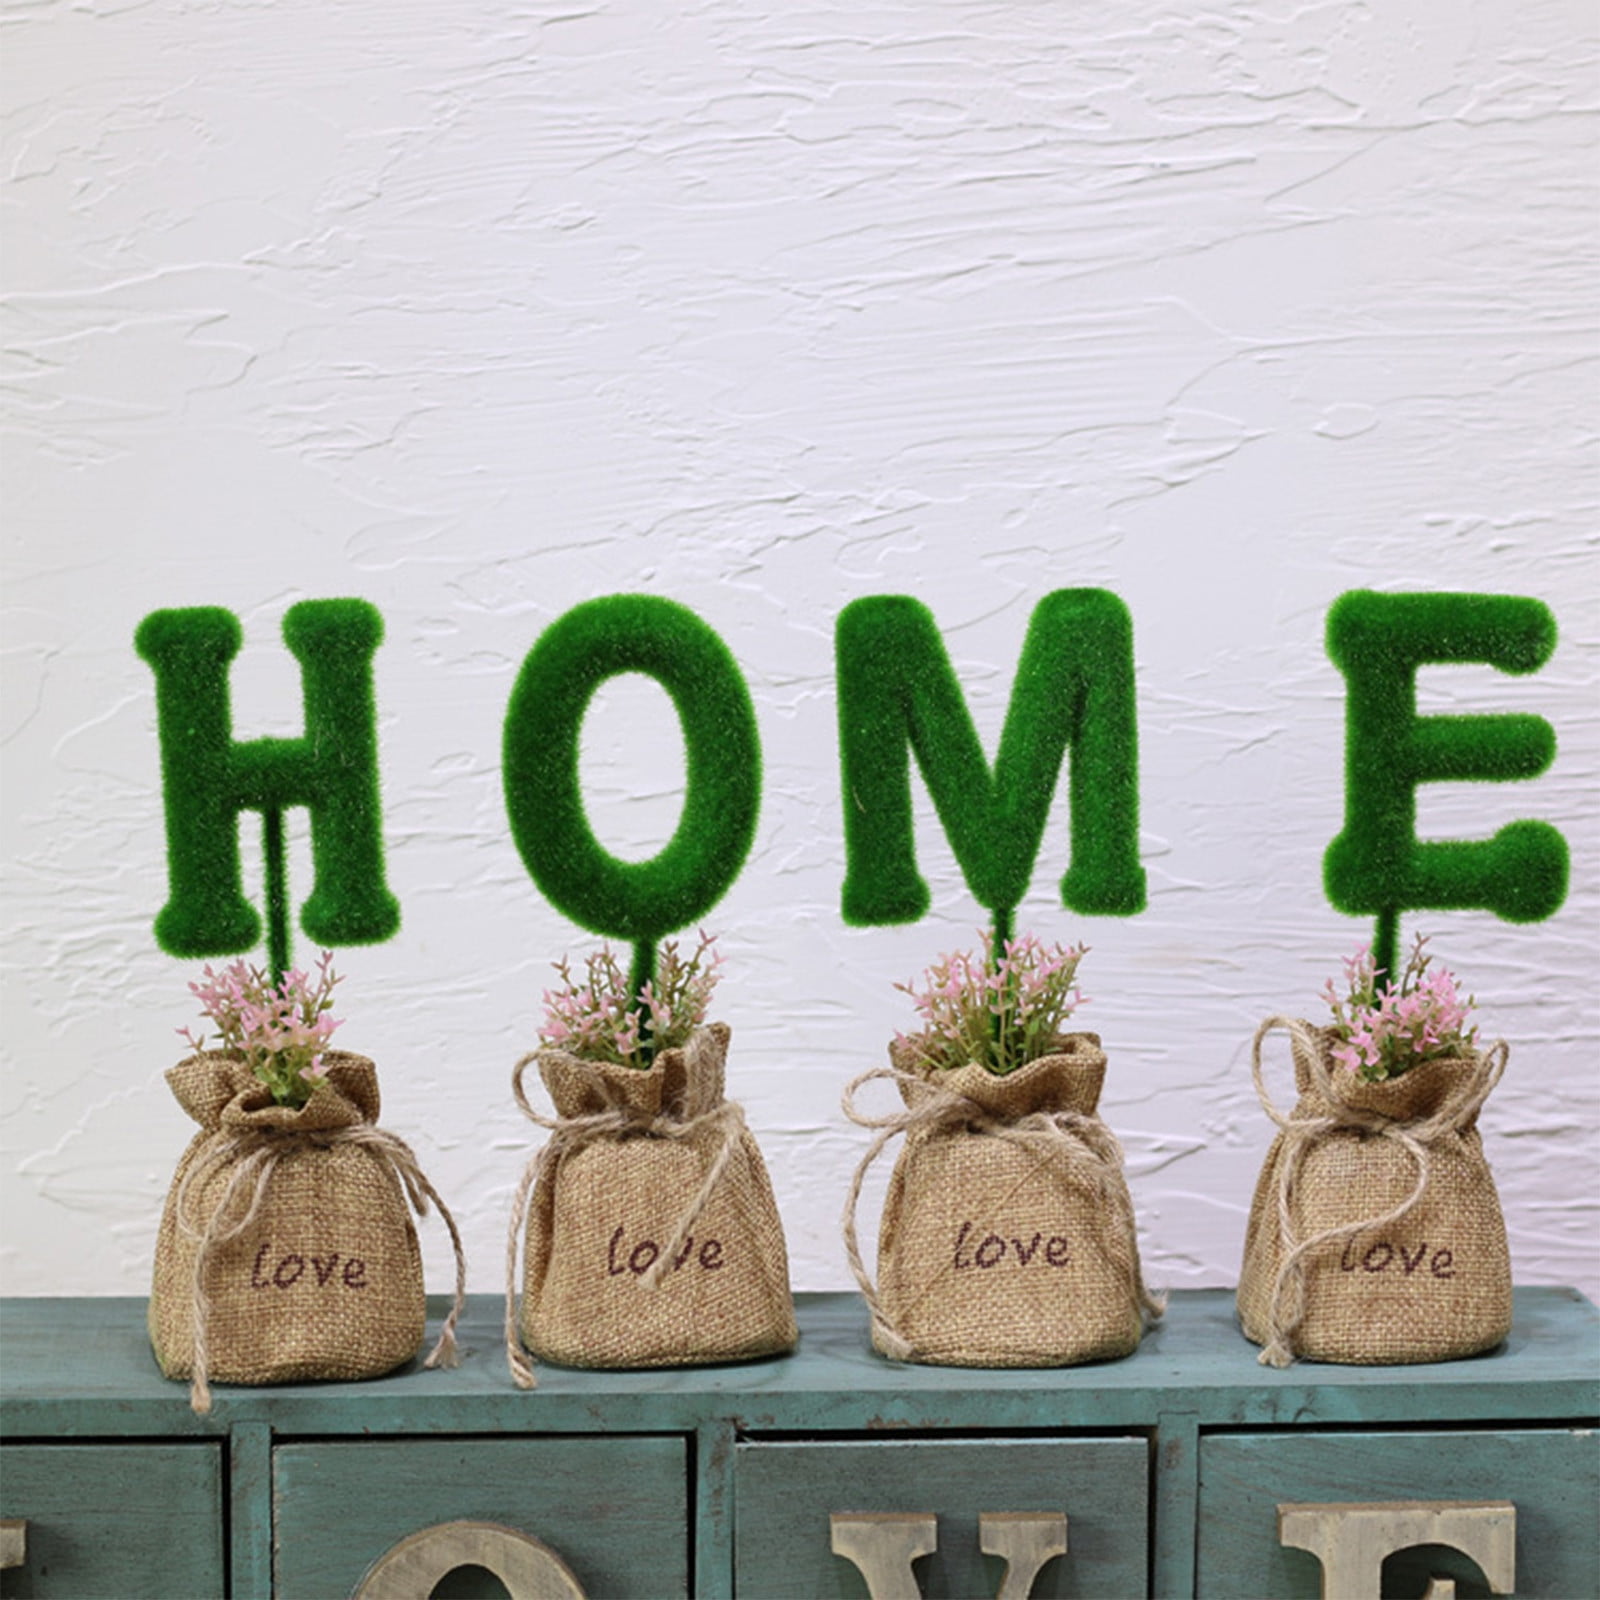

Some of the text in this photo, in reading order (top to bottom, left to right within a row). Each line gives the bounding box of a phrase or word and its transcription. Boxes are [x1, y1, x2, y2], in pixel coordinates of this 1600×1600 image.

[133, 587, 1570, 958] HOME
[252, 1243, 368, 1289] love
[953, 1221, 1070, 1270] love
[1341, 1231, 1456, 1278] love
